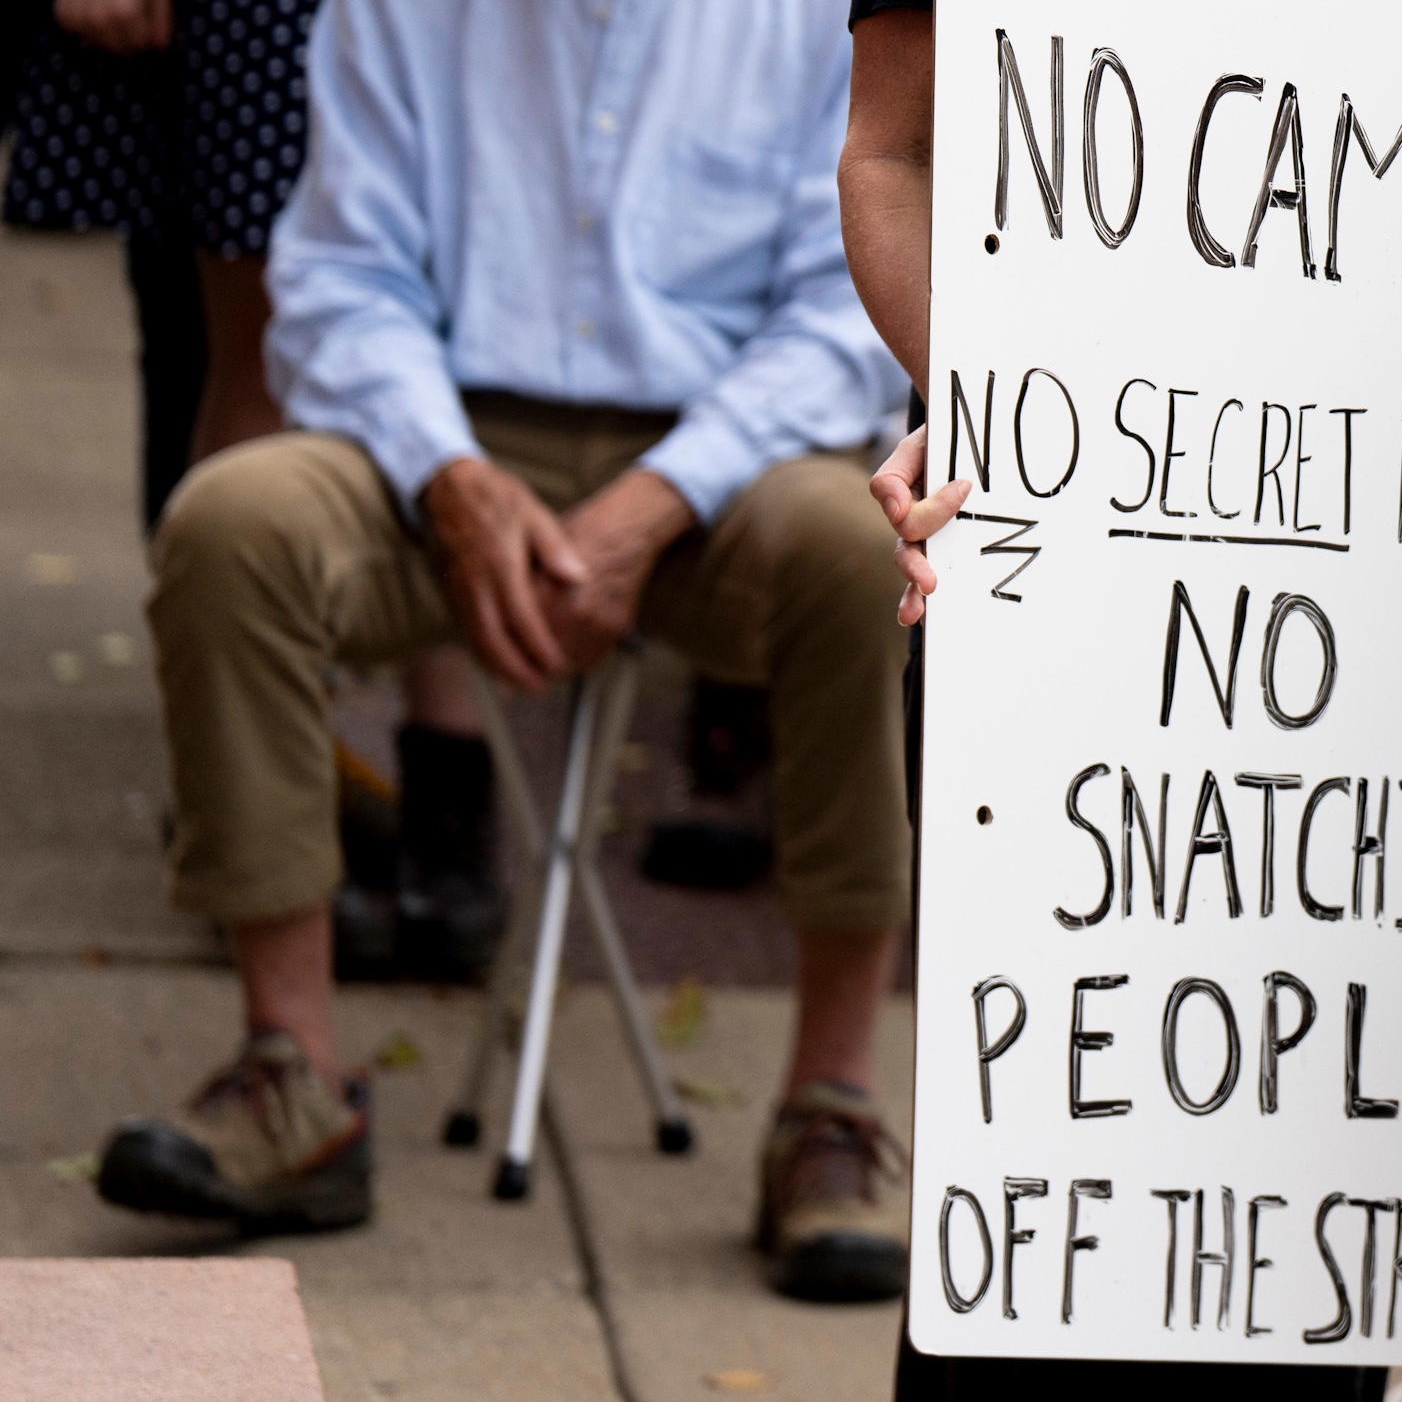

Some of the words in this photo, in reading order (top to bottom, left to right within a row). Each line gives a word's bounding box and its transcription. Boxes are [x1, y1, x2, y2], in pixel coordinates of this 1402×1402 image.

[994, 28, 1144, 250] NO
[950, 368, 1080, 498] NO
[1109, 378, 1368, 536] SECRET
[1160, 580, 1338, 731] NO
[938, 1177, 1113, 1324] OFF
[1150, 1185, 1287, 1338] THE
